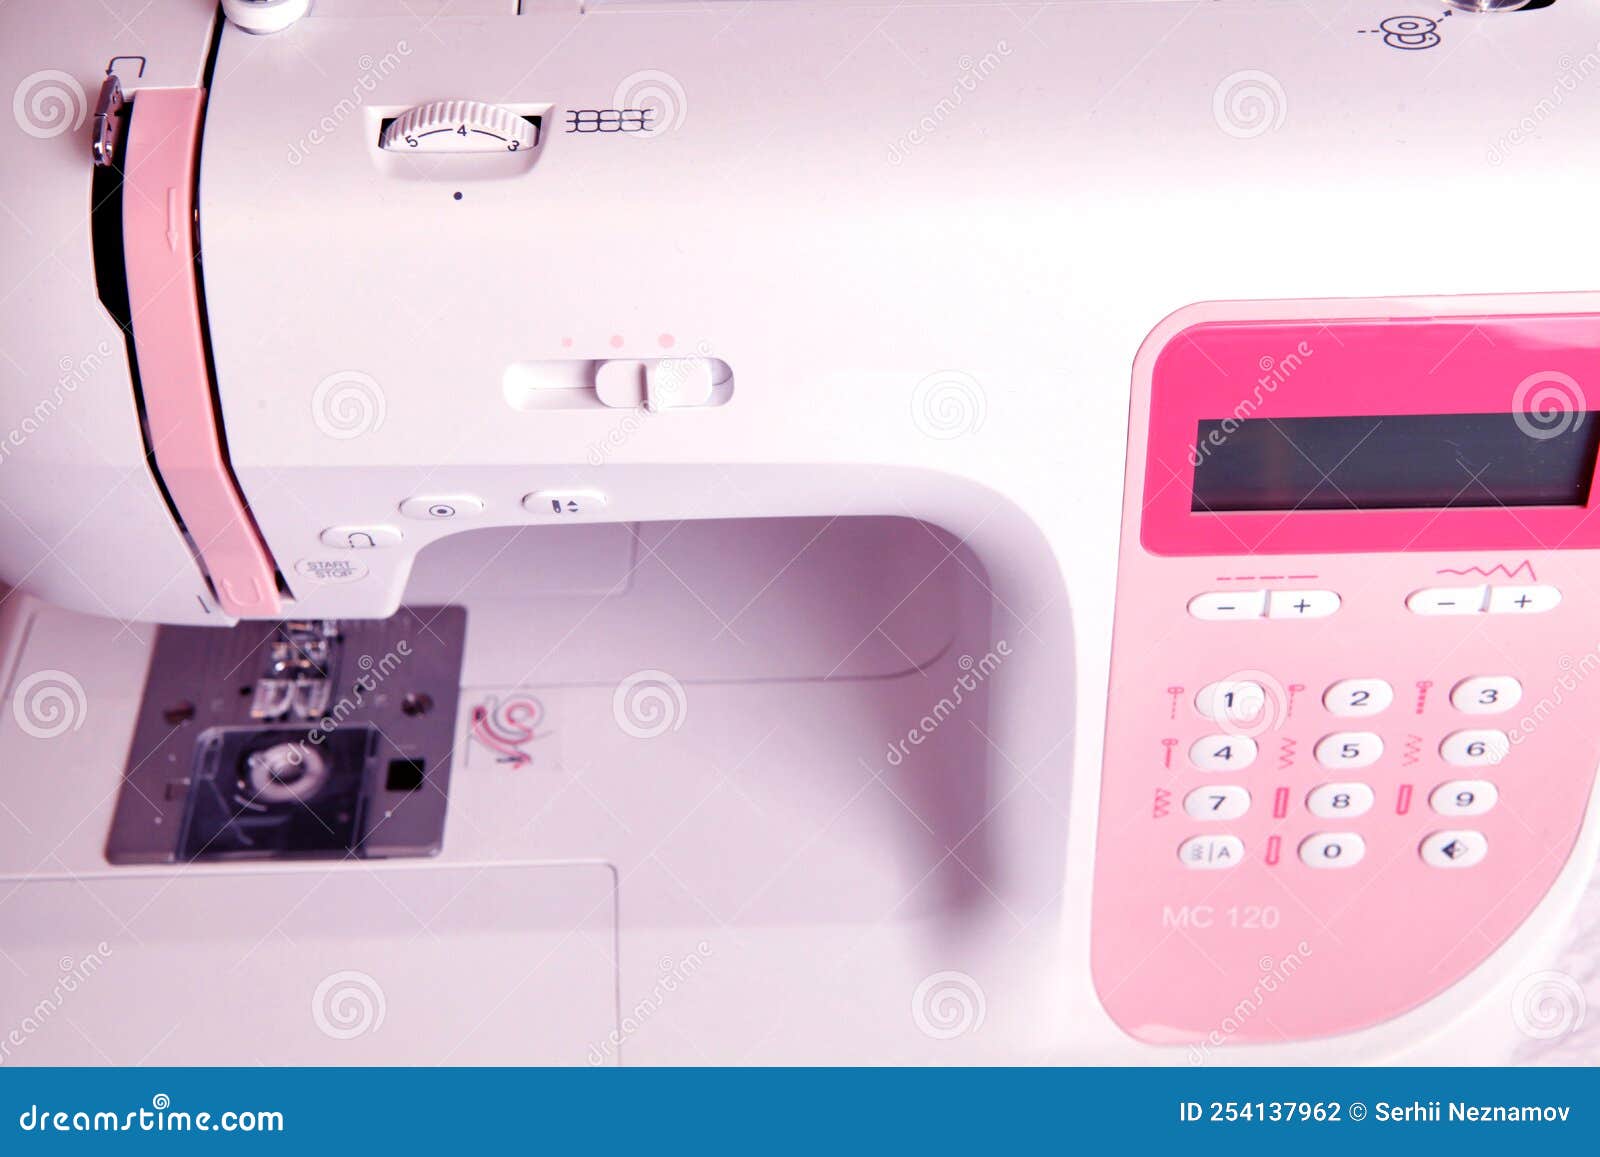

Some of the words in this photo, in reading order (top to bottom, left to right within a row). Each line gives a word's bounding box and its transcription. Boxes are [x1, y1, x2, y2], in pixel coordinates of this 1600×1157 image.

[405, 134, 419, 148] 5
[456, 124, 468, 137] 4
[507, 139, 520, 152] 3
[307, 561, 350, 570] START
[315, 569, 353, 579] STOP
[1225, 691, 1234, 708] 1
[1350, 690, 1370, 706] 2
[1479, 688, 1498, 704] 3
[1213, 745, 1232, 760] 4
[1341, 743, 1360, 758] 5
[1467, 741, 1486, 756] 6
[1209, 795, 1226, 811] 7
[1332, 793, 1351, 809] 8
[1456, 791, 1475, 807] 9
[1162, 904, 1215, 928] MC
[1225, 904, 1281, 929] 120
